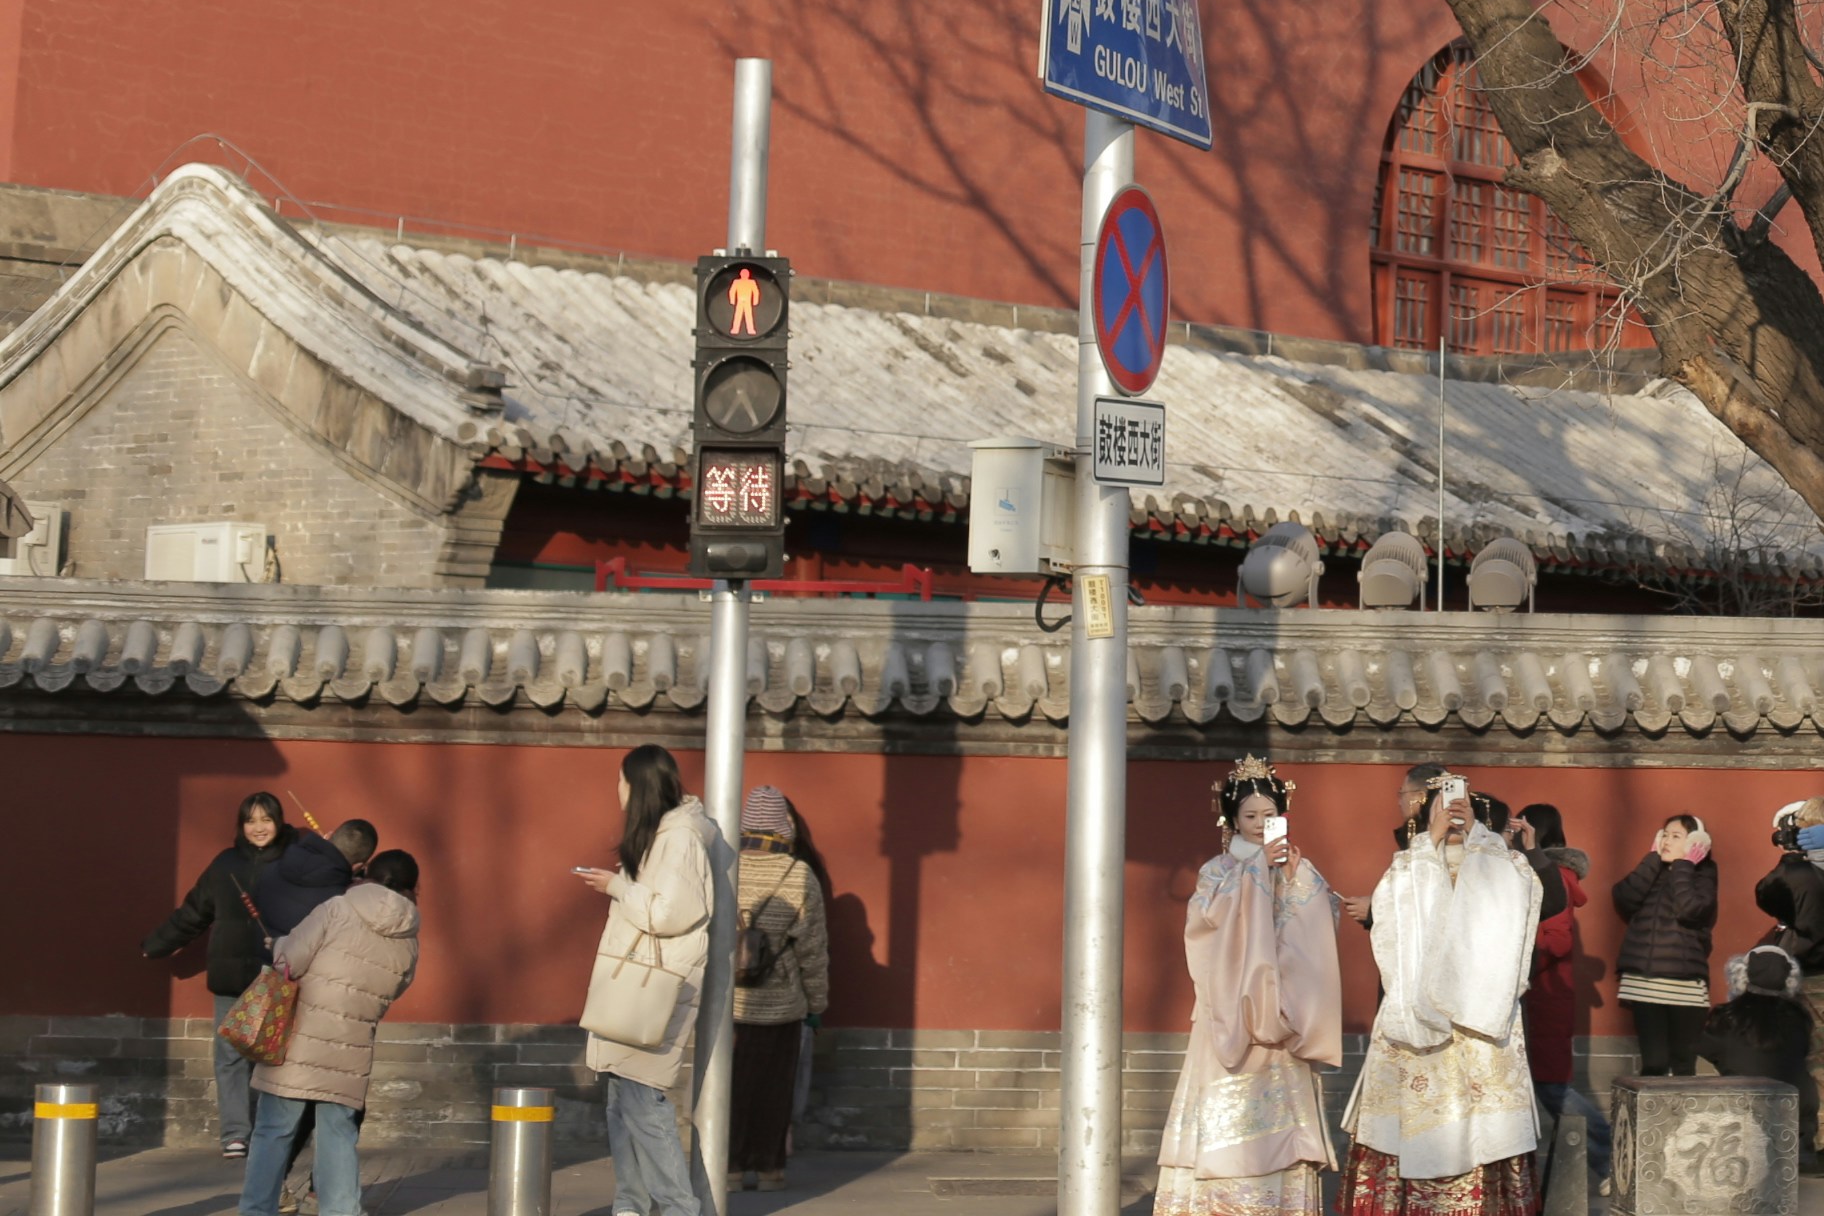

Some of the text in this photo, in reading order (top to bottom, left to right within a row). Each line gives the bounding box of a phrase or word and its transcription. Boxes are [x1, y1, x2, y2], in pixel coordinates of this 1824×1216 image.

[1070, 20, 1080, 46] W
[1094, 44, 1204, 119] GULOU West St
[1098, 413, 1162, 471] 鼓楼西大街
[704, 466, 769, 513] 等待
[1677, 1121, 1750, 1188] 福
